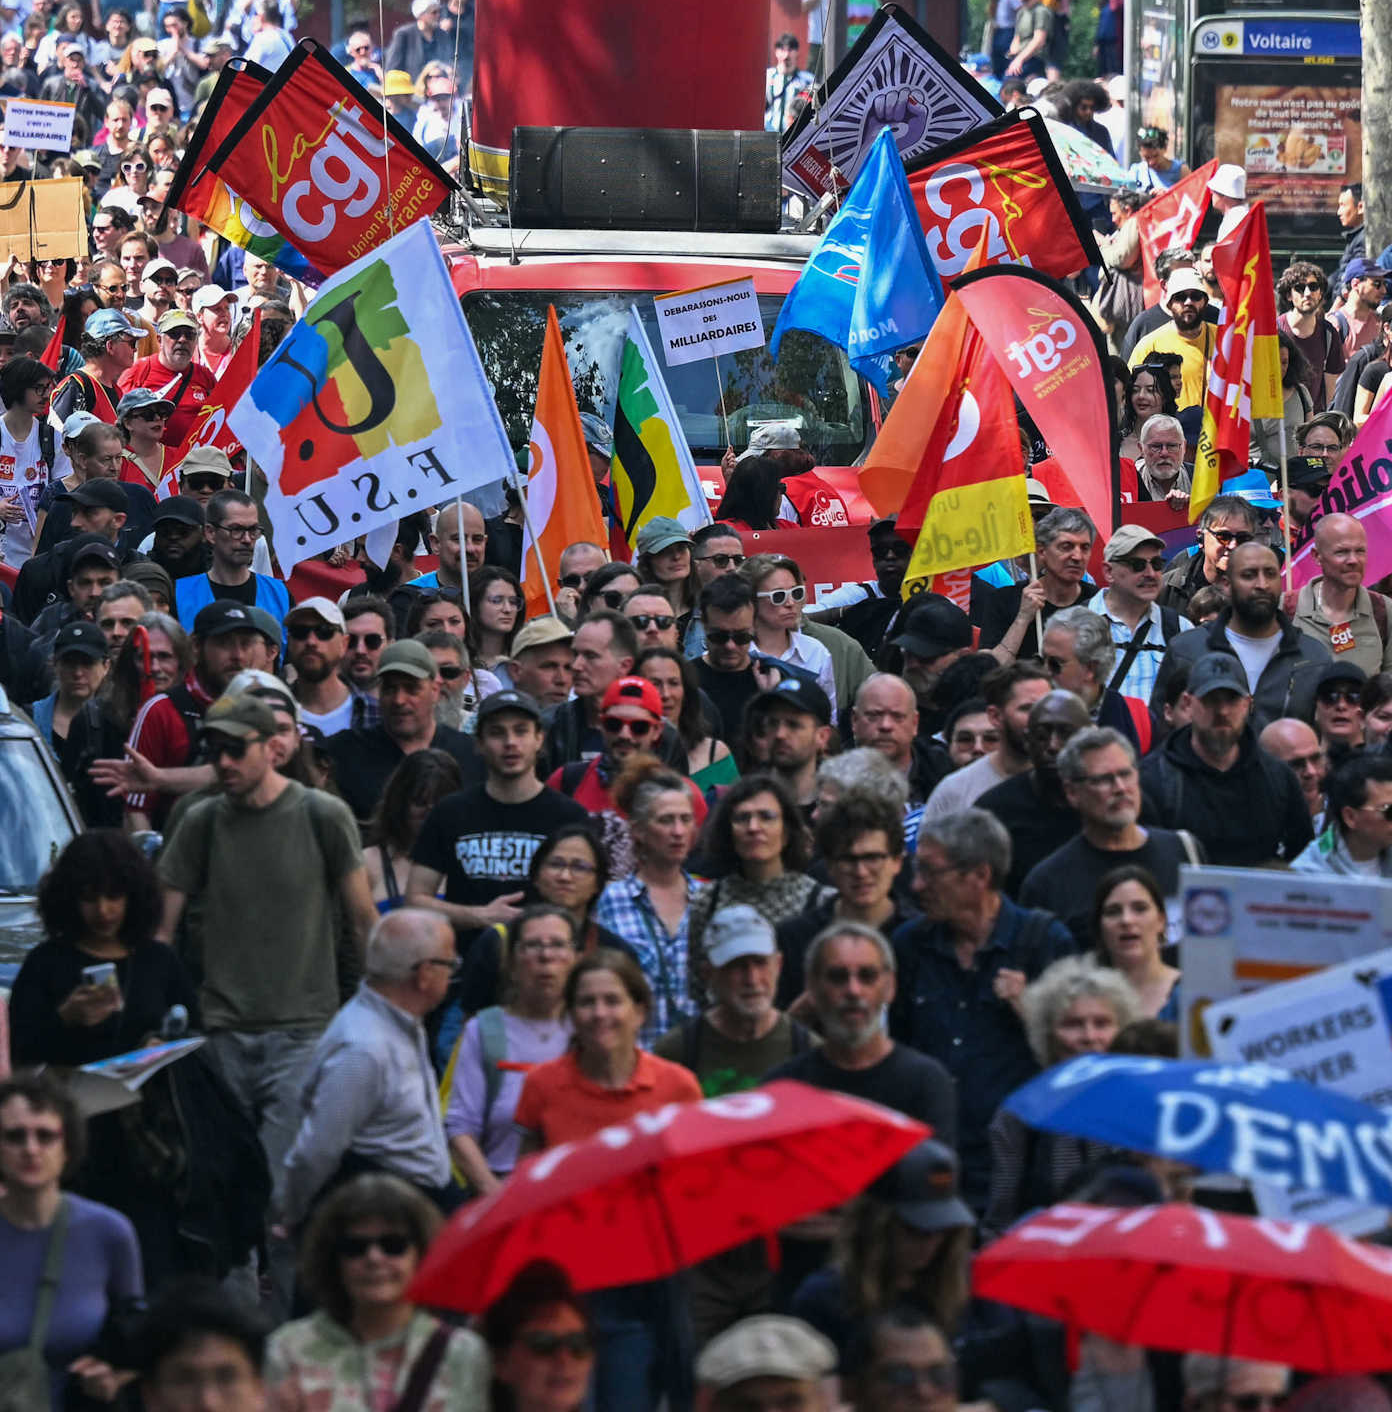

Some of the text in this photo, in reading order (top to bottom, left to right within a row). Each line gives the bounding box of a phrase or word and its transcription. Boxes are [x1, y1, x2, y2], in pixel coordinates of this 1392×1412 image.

[1226, 35, 1234, 46] 9
[1249, 33, 1312, 50] Voltaire
[1230, 97, 1258, 108] Notre
[1307, 99, 1325, 111] pas
[1269, 109, 1289, 118] tout
[1248, 119, 1268, 129] Mais
[282, 100, 396, 243] cgt
[347, 163, 423, 261] Union Régionale
[663, 290, 751, 318] DEBARASSONS-NOUS
[702, 313, 718, 324] DES
[669, 320, 758, 350] MILLIARDAIRES
[1331, 627, 1354, 645] cgt
[1237, 1003, 1377, 1064] WORKERS
